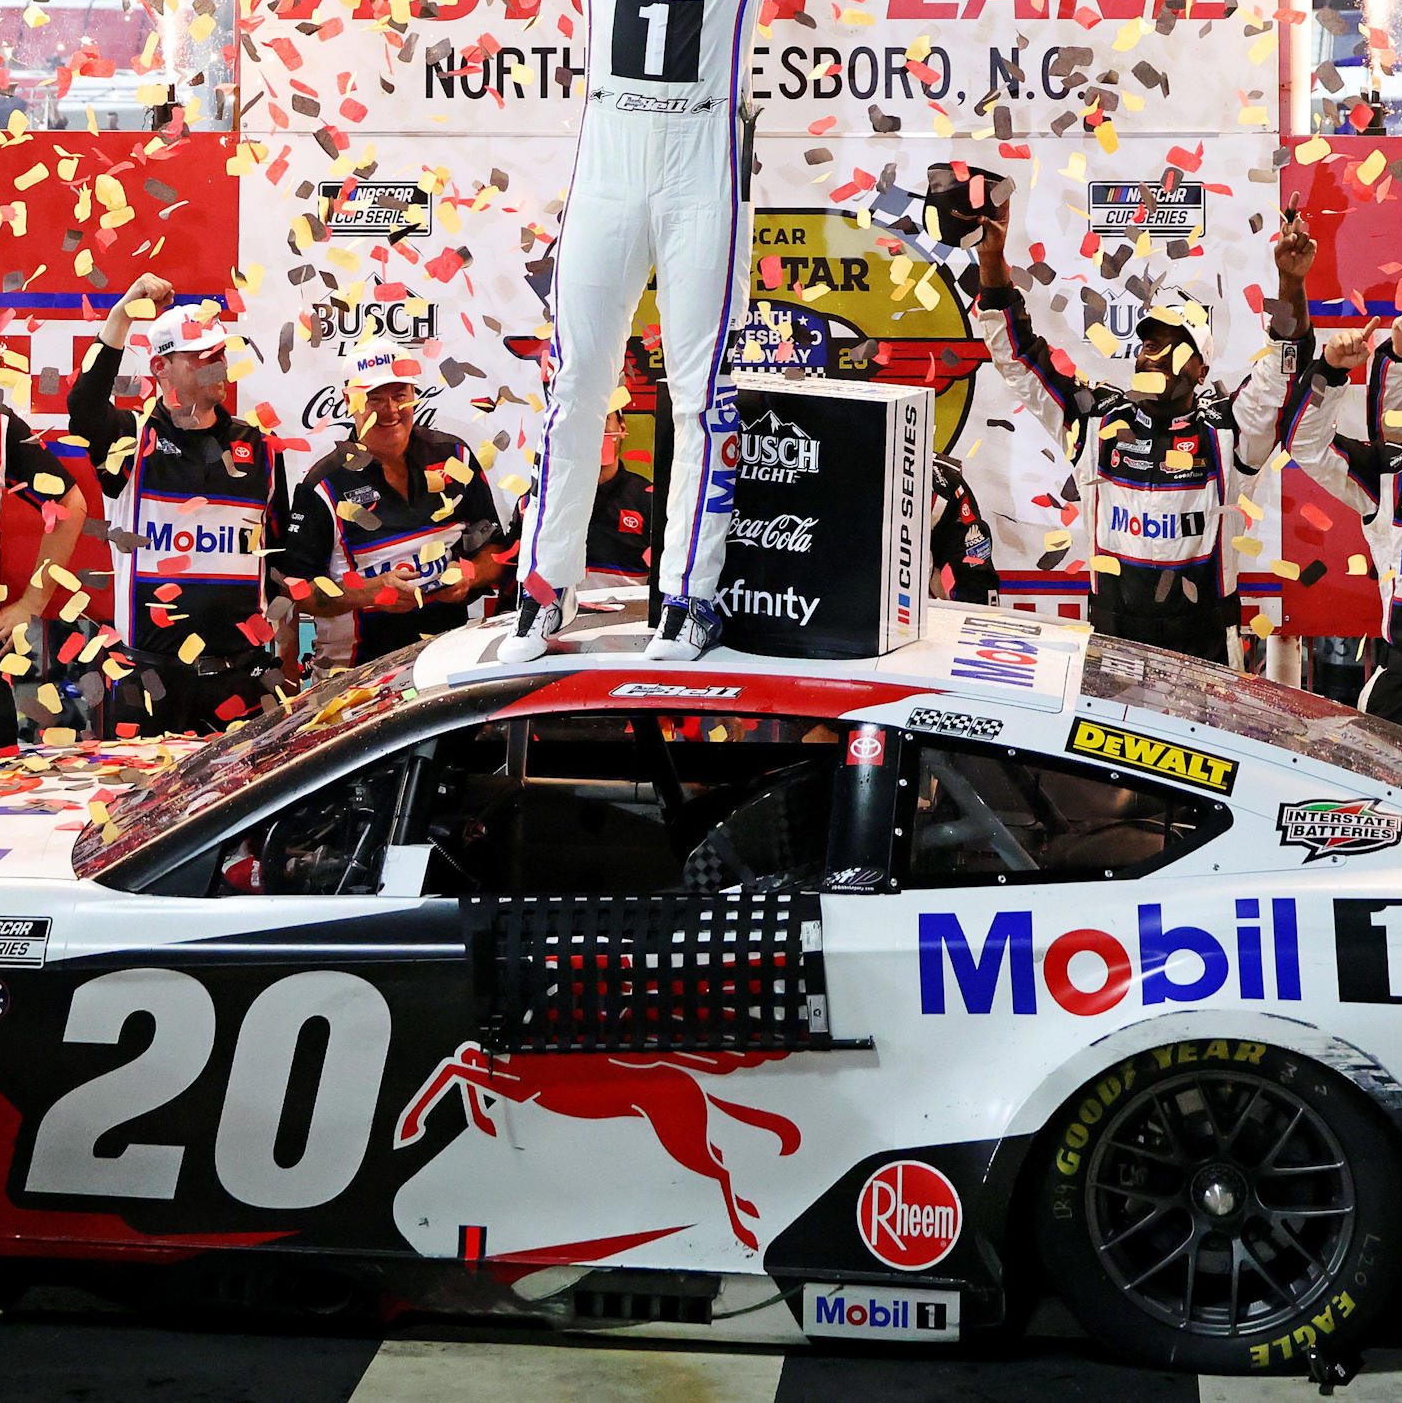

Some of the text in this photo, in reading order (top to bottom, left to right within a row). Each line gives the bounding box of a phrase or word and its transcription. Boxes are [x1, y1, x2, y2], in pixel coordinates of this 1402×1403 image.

[638, 3, 670, 76] 1
[425, 46, 586, 99] NORTH
[365, 209, 416, 225] SERIE
[1106, 211, 1188, 224] CUP ERIES
[313, 302, 438, 340] BUSCH
[357, 354, 391, 372] Mobil
[741, 465, 797, 484] LIGHT
[898, 403, 918, 590] CUP SERIES
[146, 521, 234, 555] Mobil
[1111, 506, 1176, 539] Mobil
[713, 578, 820, 627] xfinity
[1287, 810, 1397, 830] INTERSTATE
[1293, 824, 1393, 841] BATTERIES
[919, 898, 1301, 1016] Mobil
[24, 968, 392, 1210] 20
[870, 1164, 955, 1251] Rheem
[816, 1296, 908, 1329] Mobil
[1250, 1289, 1356, 1369] EAGLE
